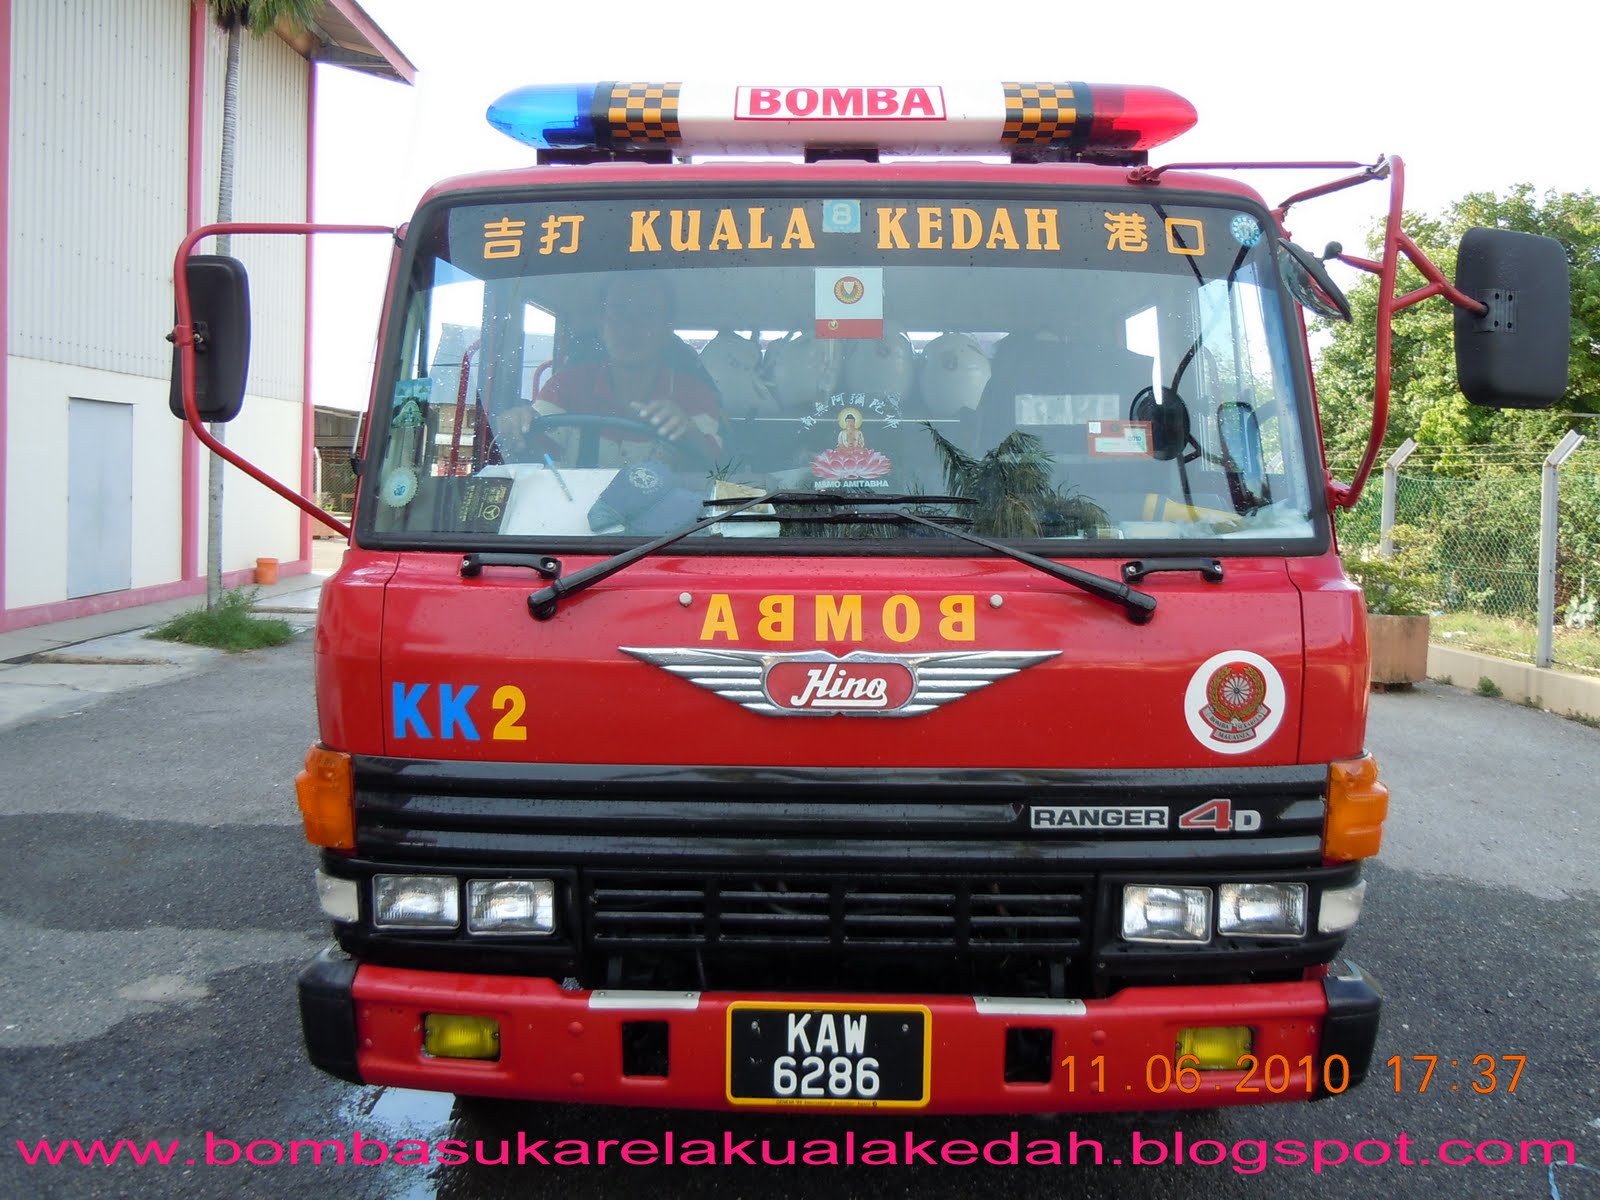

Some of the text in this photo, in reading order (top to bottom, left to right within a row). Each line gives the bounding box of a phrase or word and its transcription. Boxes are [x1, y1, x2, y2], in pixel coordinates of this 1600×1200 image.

[749, 88, 936, 117] BOMBA
[484, 214, 585, 259] 吉打
[629, 207, 1060, 252] KUALA KEDAH
[1104, 212, 1205, 256] 港口
[814, 480, 889, 489] NAMO AMITABHA
[790, 664, 888, 707] Hino
[392, 681, 527, 741] KK 2
[1034, 809, 1165, 826] RANGER
[787, 1013, 867, 1054] KAW
[773, 1056, 880, 1097] 6286
